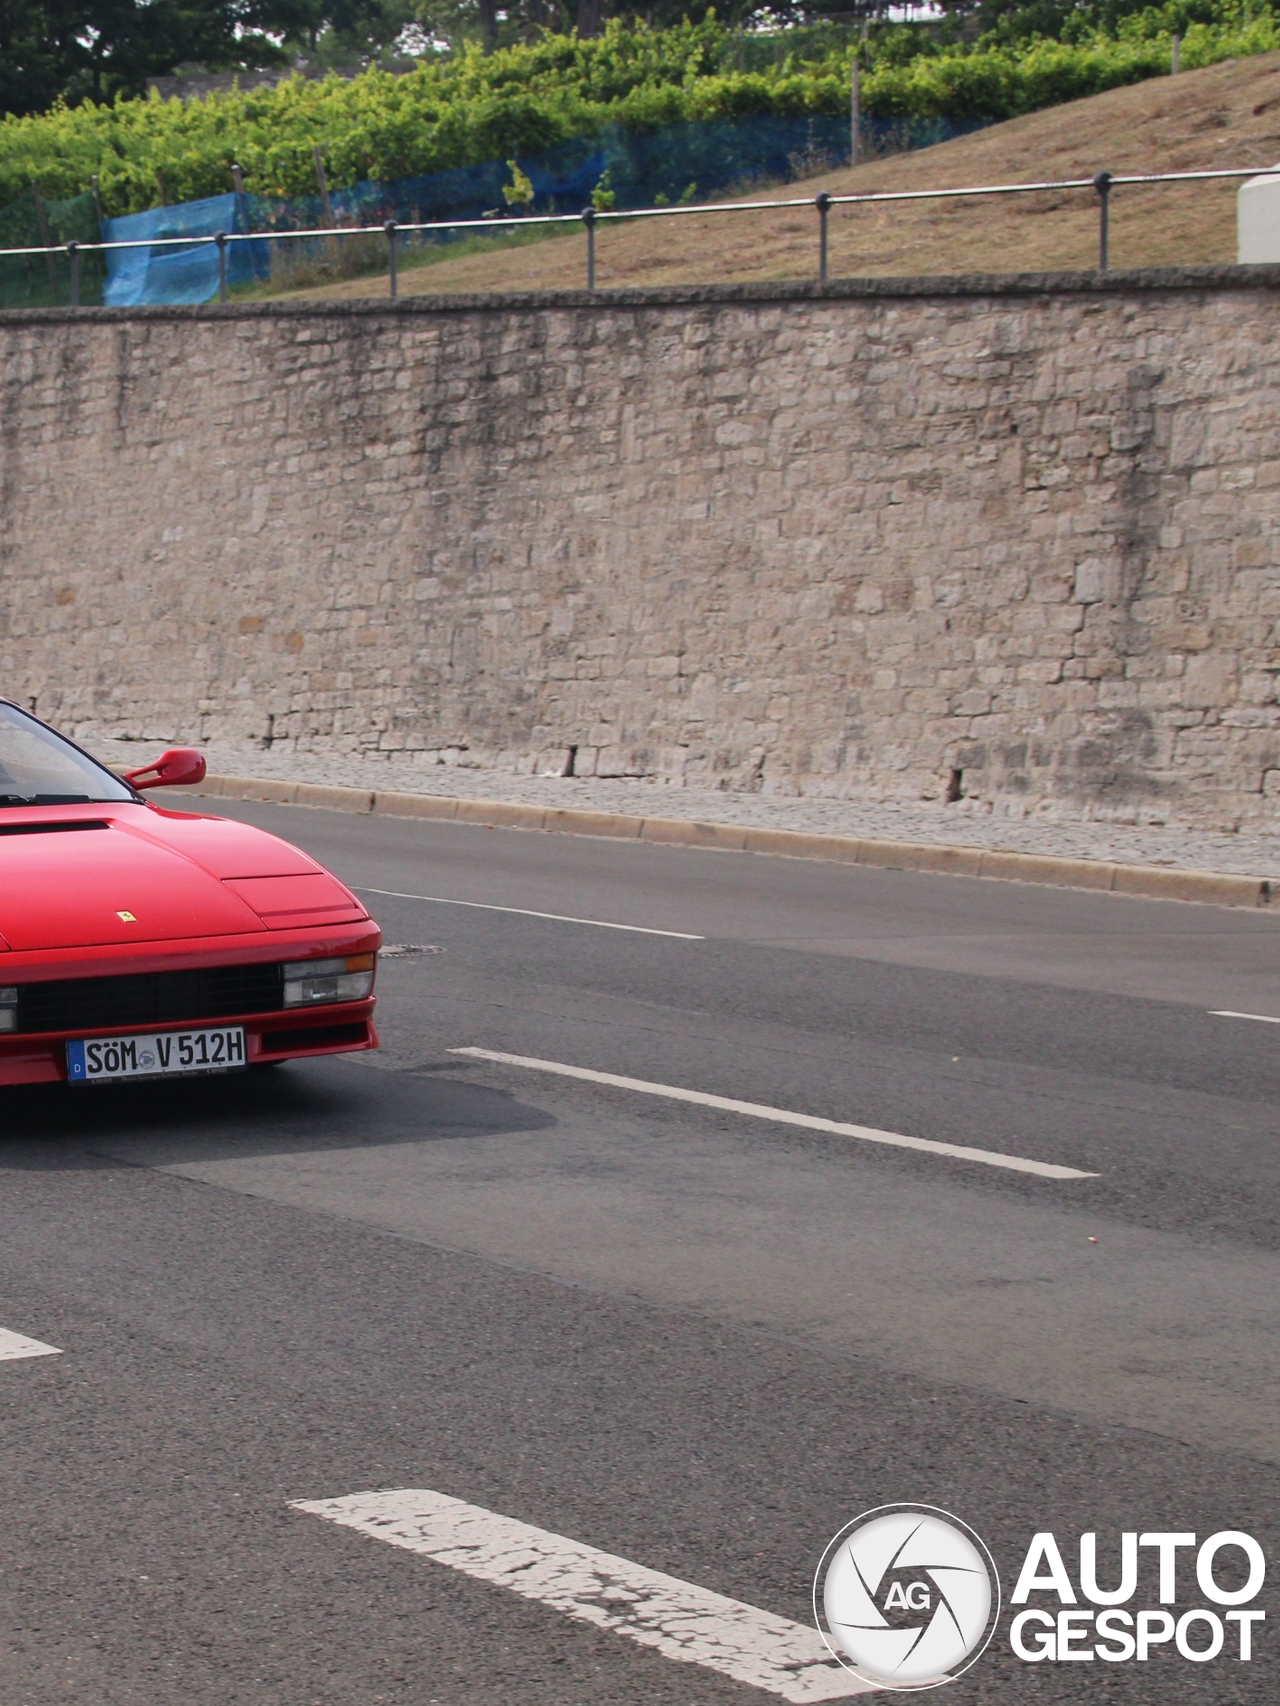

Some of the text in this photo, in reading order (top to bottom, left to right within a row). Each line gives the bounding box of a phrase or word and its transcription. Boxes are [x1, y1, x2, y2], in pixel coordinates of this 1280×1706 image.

[86, 1031, 243, 1074] SÖM V 512H
[74, 1064, 81, 1073] D
